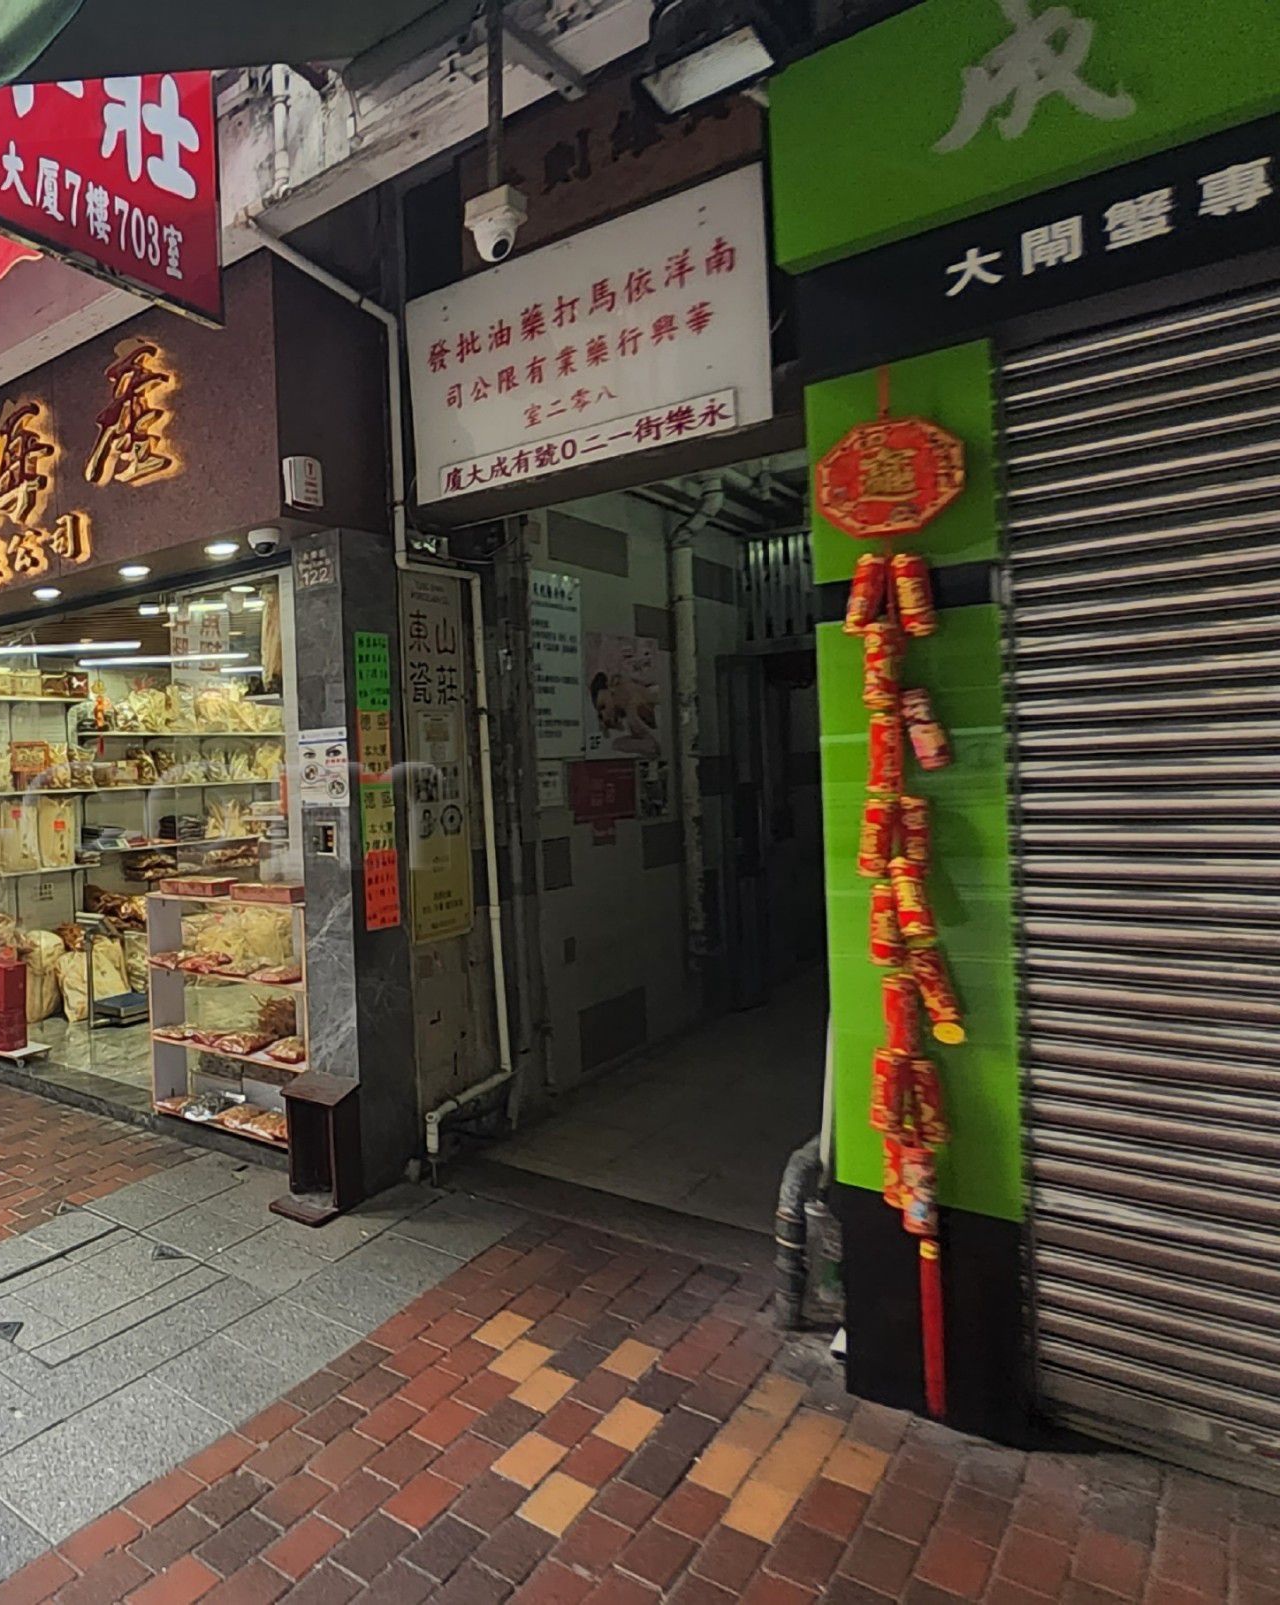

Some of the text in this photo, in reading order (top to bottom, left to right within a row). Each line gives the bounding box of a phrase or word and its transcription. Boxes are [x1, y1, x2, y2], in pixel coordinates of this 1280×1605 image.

[945, 156, 1274, 298] 大閘蟹專
[409, 609, 456, 655] 東山
